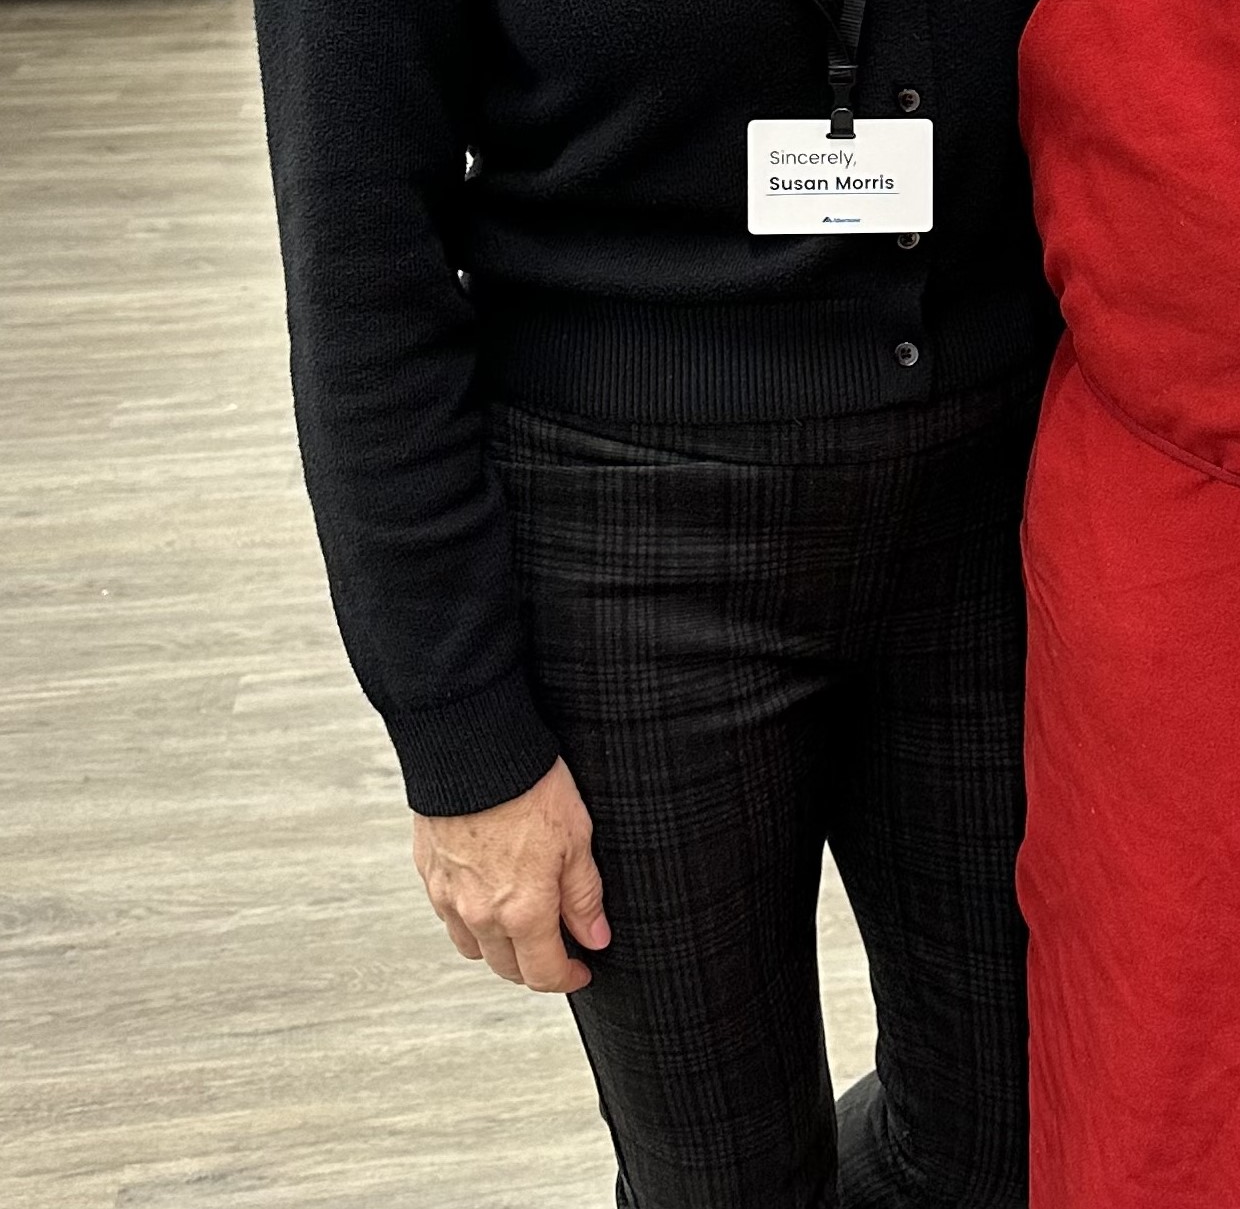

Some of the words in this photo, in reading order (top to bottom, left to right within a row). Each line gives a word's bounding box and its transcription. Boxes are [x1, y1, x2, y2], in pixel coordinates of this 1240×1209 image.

[769, 150, 857, 169] Sincerely,
[769, 176, 829, 191] Susan
[835, 175, 895, 190] Morris
